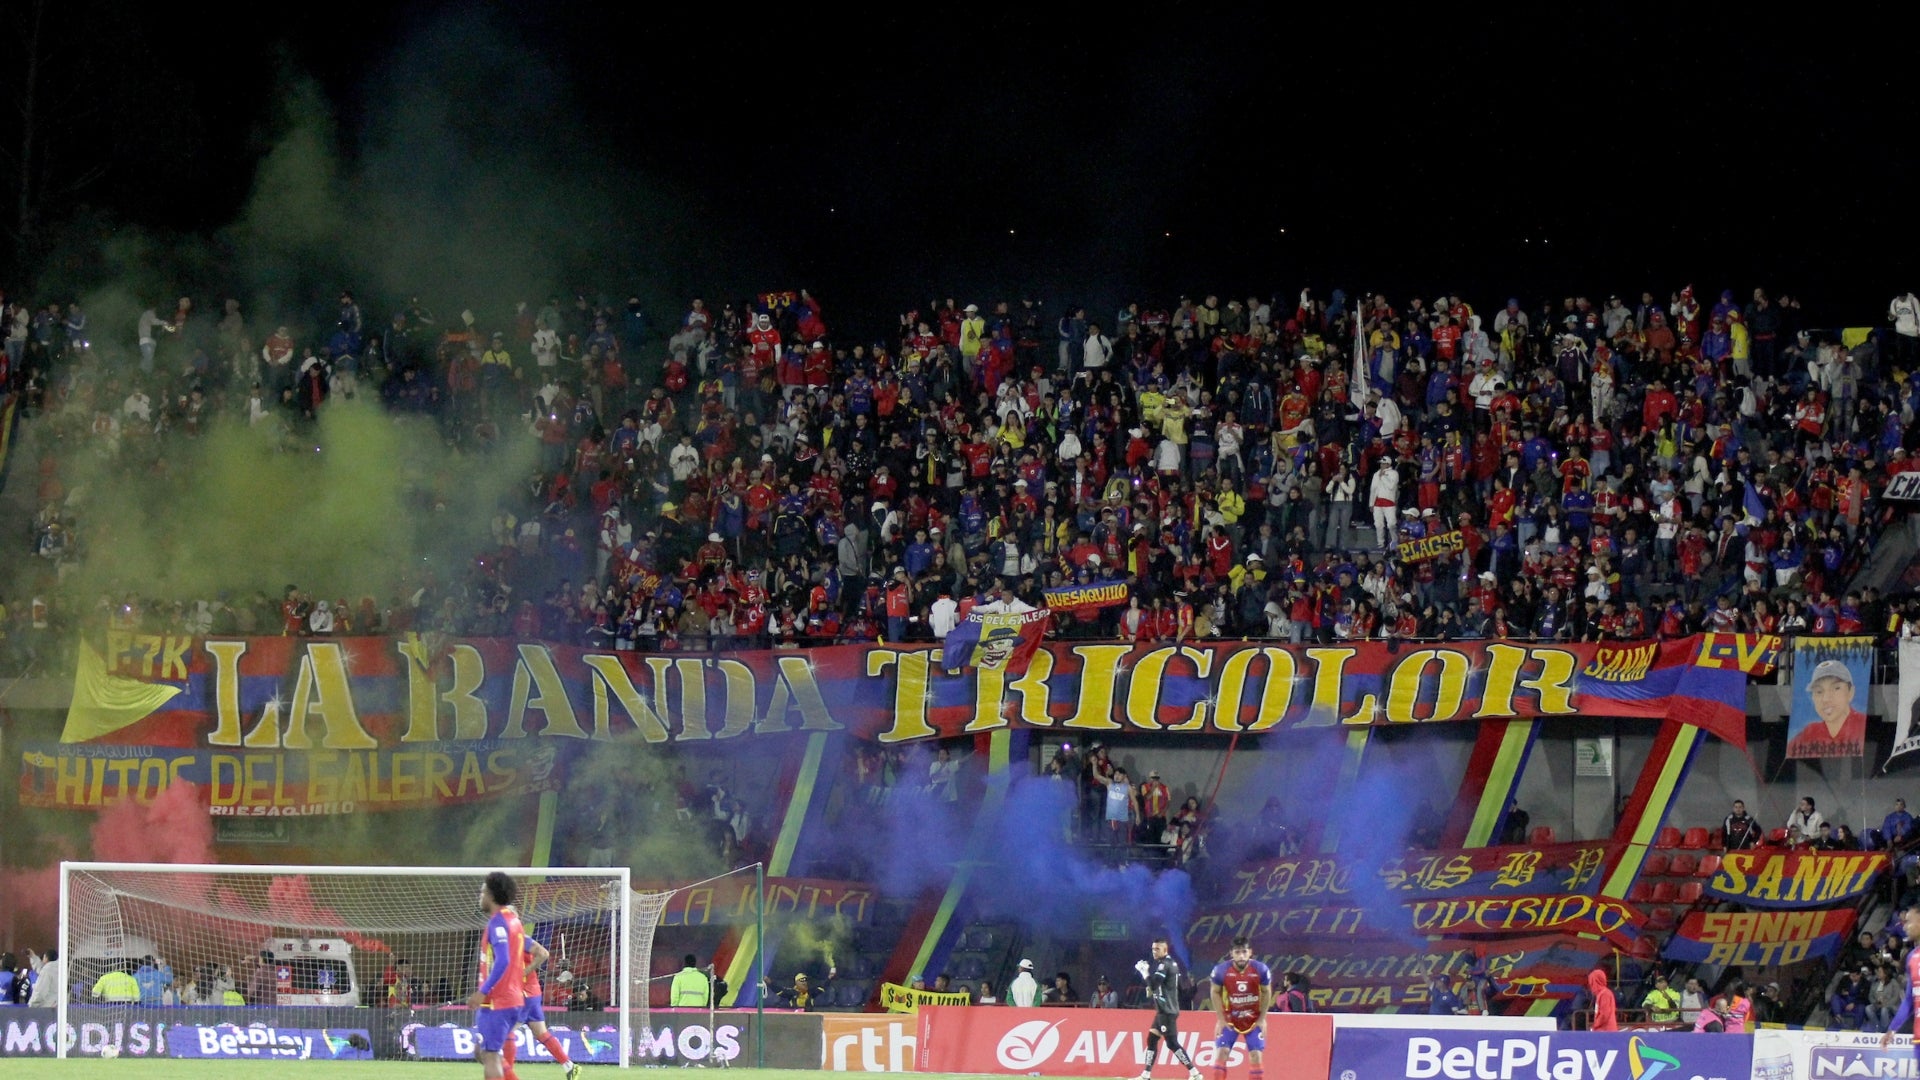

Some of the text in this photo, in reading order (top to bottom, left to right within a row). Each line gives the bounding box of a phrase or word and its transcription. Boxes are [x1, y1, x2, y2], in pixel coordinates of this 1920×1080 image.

[985, 615, 1005, 626] DEL
[205, 640, 1577, 750] LA BANDA TRICOLOR
[211, 753, 295, 806] DEL
[307, 749, 517, 802] GALERAS
[1711, 853, 1887, 902] SANMI
[1700, 911, 1827, 943] SANMI
[1702, 940, 1811, 966] ALTO
[198, 1026, 312, 1059] BetPlay
[821, 1022, 917, 1072] rth
[1064, 1030, 1127, 1062] AV
[1132, 1030, 1246, 1068] Villas
[1405, 1035, 1618, 1080] BetPlay
